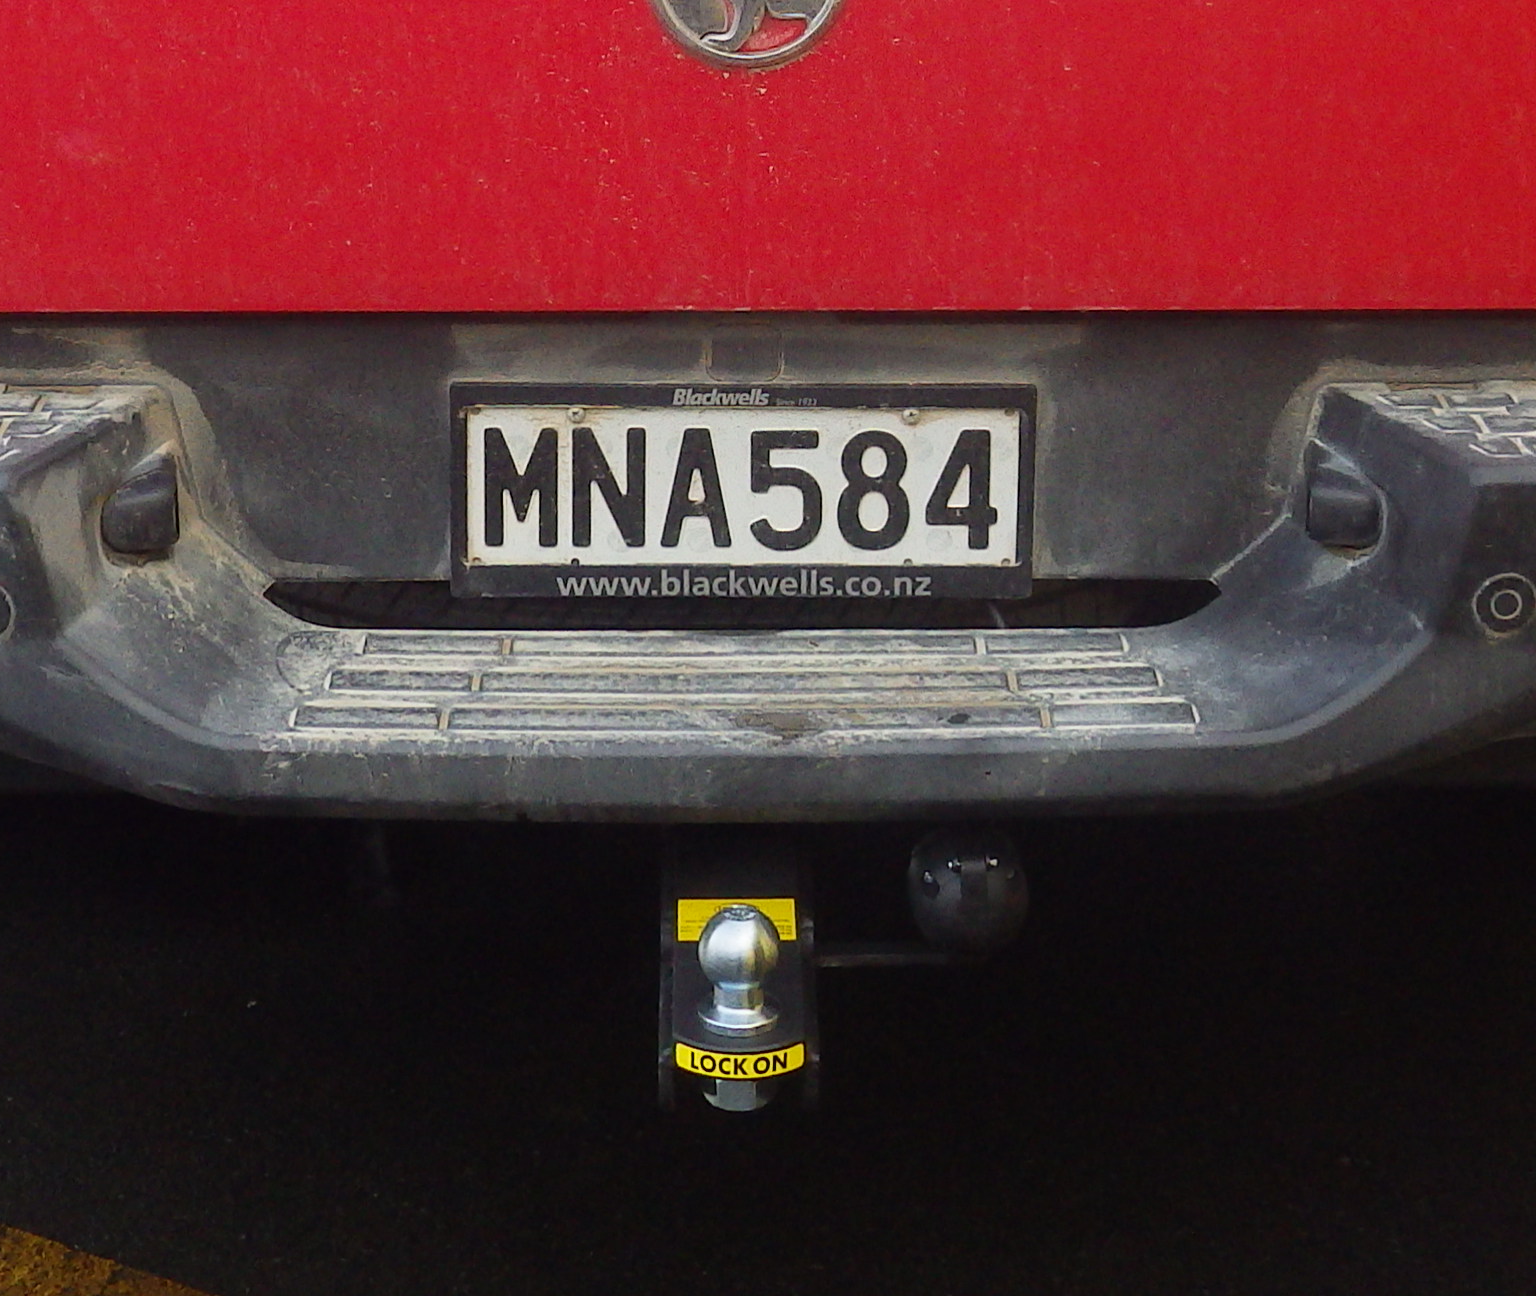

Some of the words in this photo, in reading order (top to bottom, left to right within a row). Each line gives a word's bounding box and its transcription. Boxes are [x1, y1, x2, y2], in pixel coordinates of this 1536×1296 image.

[672, 388, 770, 406] Blackwells
[484, 427, 998, 551] MNA584
[556, 569, 932, 597] www.blackwells.co.nz
[690, 1051, 748, 1076] LOCK
[752, 1052, 789, 1075] ON
